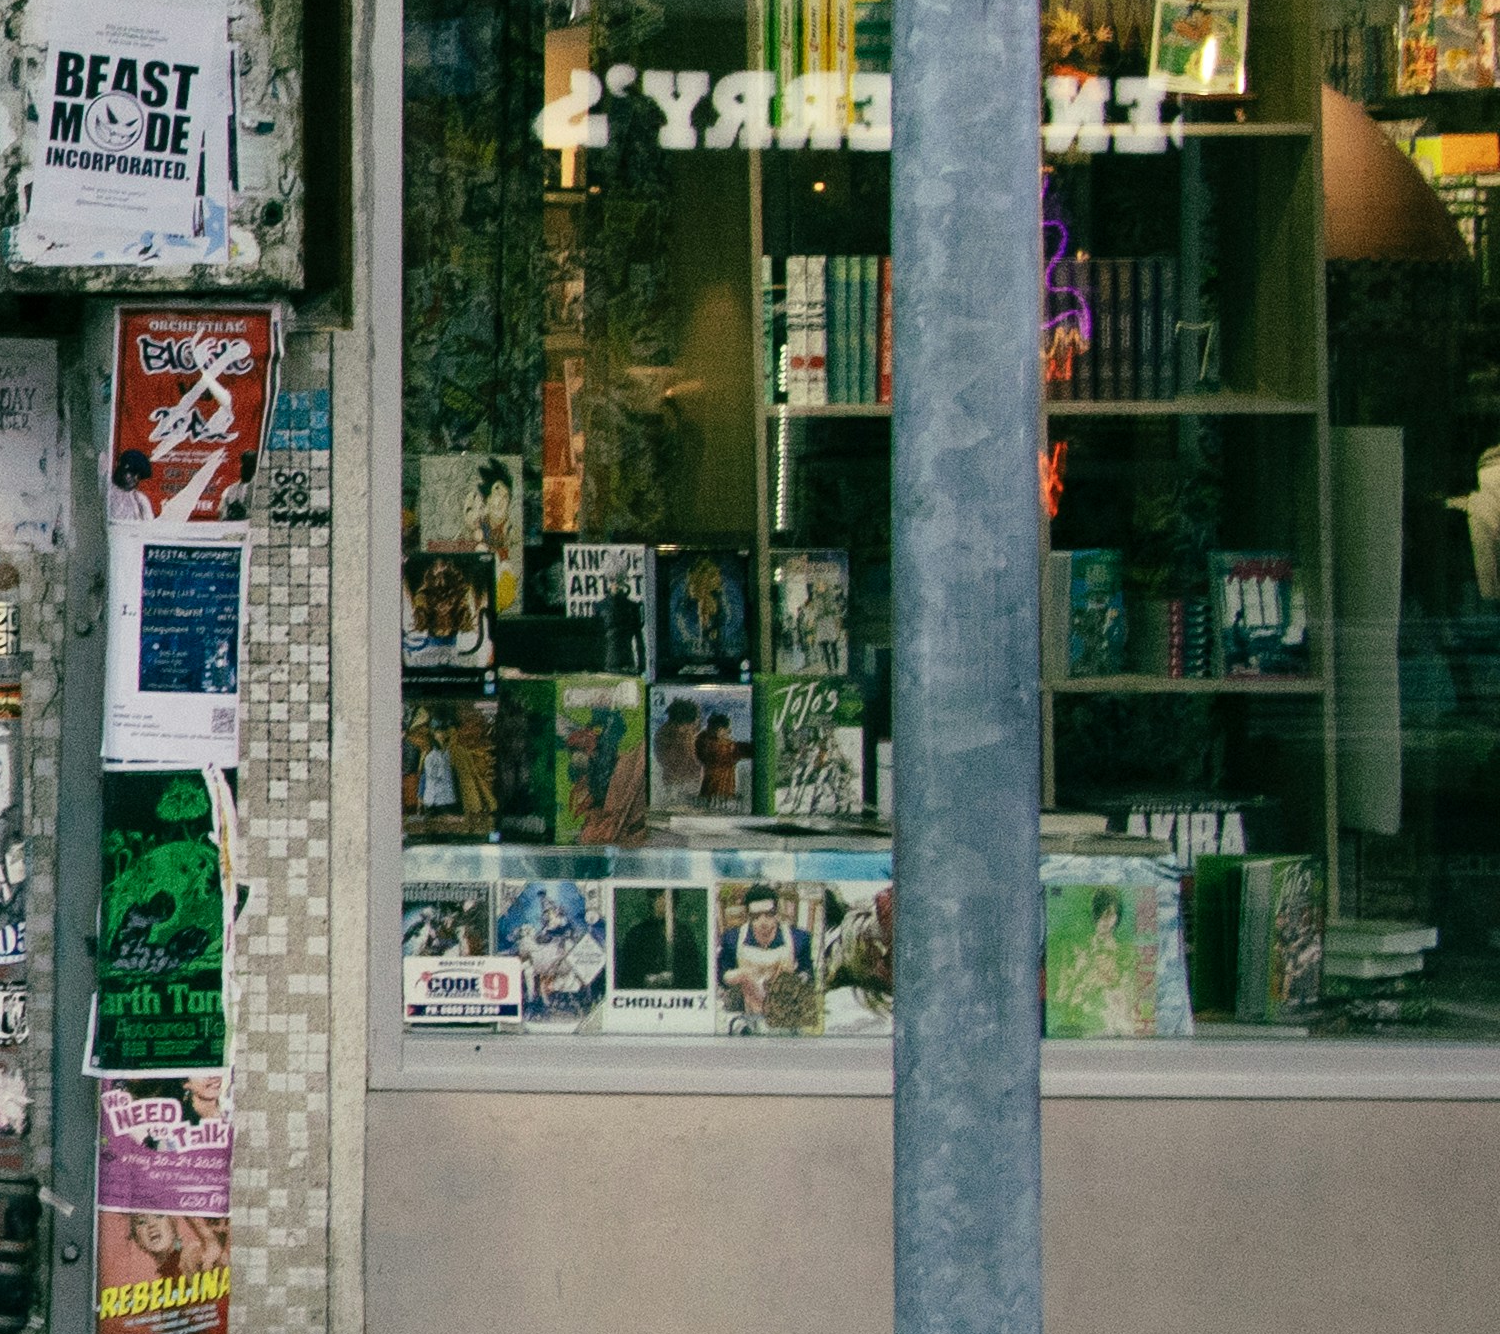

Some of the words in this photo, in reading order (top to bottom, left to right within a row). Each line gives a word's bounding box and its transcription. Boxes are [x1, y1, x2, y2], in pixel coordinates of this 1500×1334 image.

[54, 50, 200, 111] BEAST
[45, 145, 191, 182] INCORPORATED.
[570, 573, 643, 597] ARTST
[427, 976, 481, 996] CODE
[483, 971, 509, 1001] 9
[612, 995, 694, 1009] CHOUJIN
[115, 1102, 177, 1131] NEED
[172, 1123, 226, 1148] Talk
